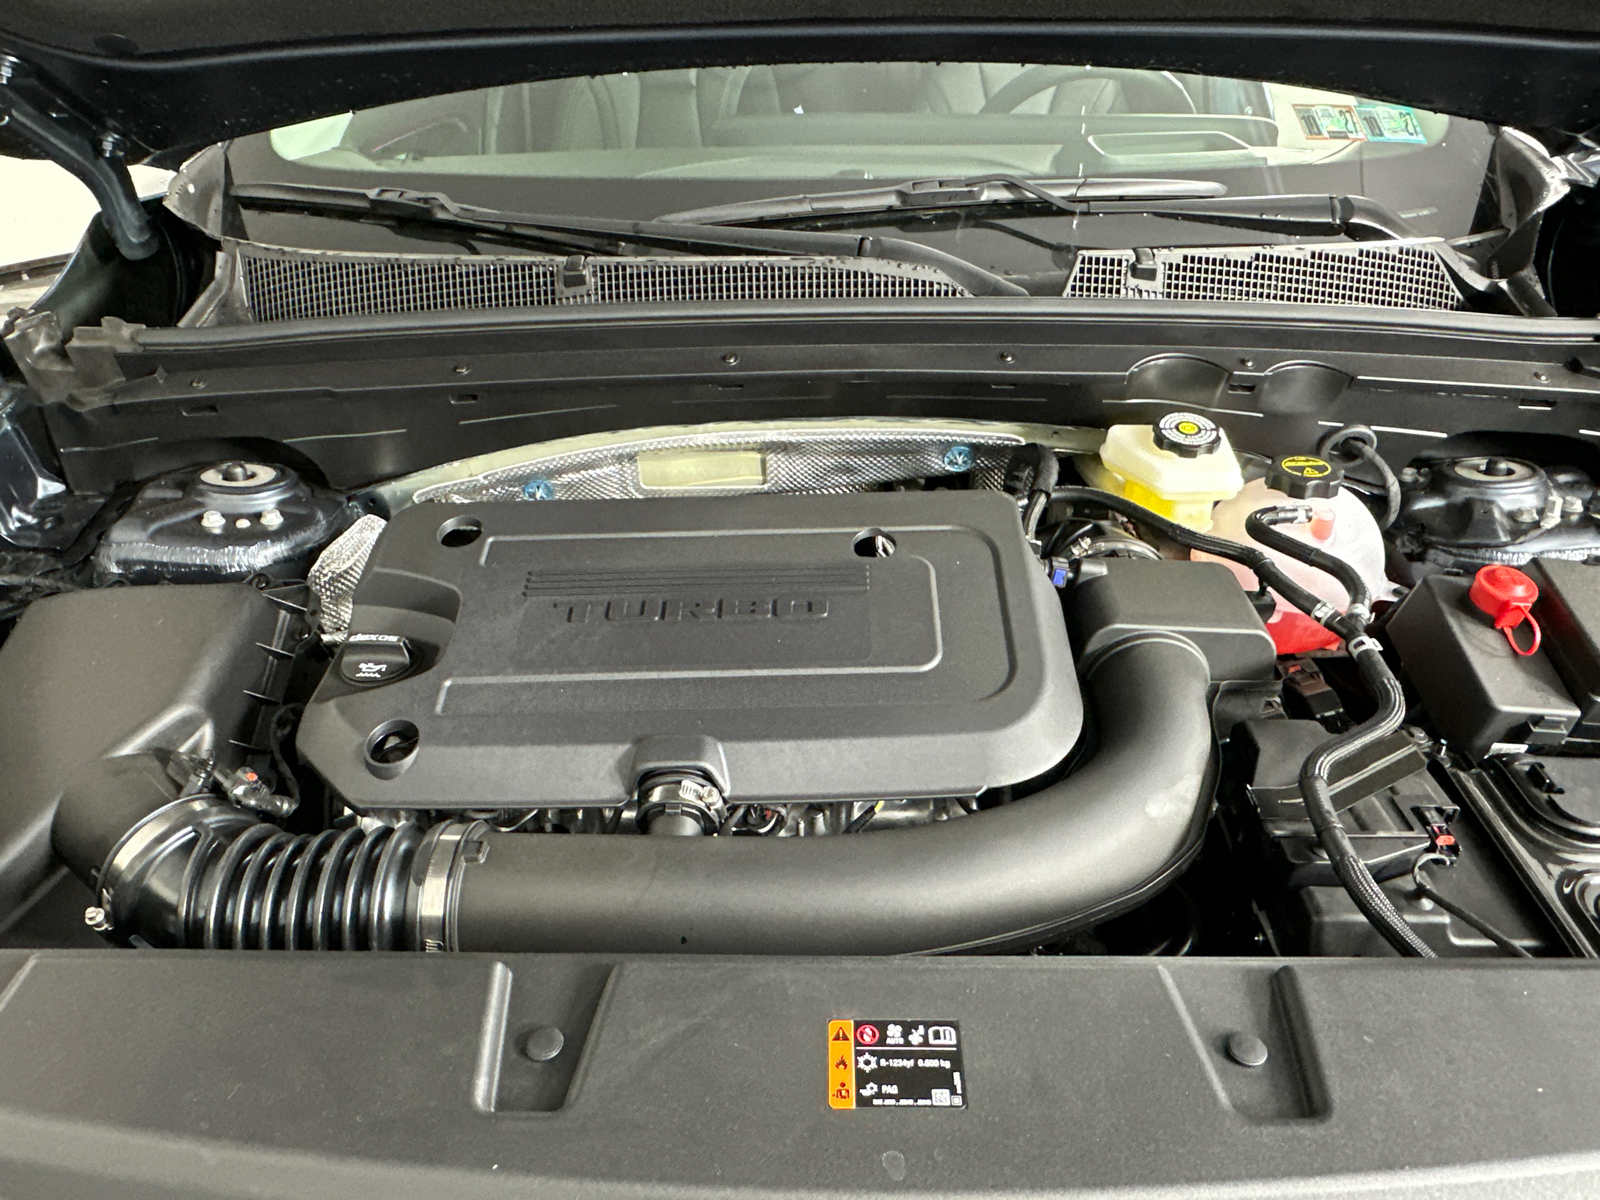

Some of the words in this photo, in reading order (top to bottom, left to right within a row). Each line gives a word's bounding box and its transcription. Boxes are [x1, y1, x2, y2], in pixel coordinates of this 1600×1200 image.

[1300, 114, 1323, 136] 10
[1338, 109, 1359, 136] 27
[1362, 115, 1385, 137] 10
[552, 598, 830, 624] TURBO
[886, 1037, 904, 1045] AUTO
[881, 1085, 899, 1095] PAG
